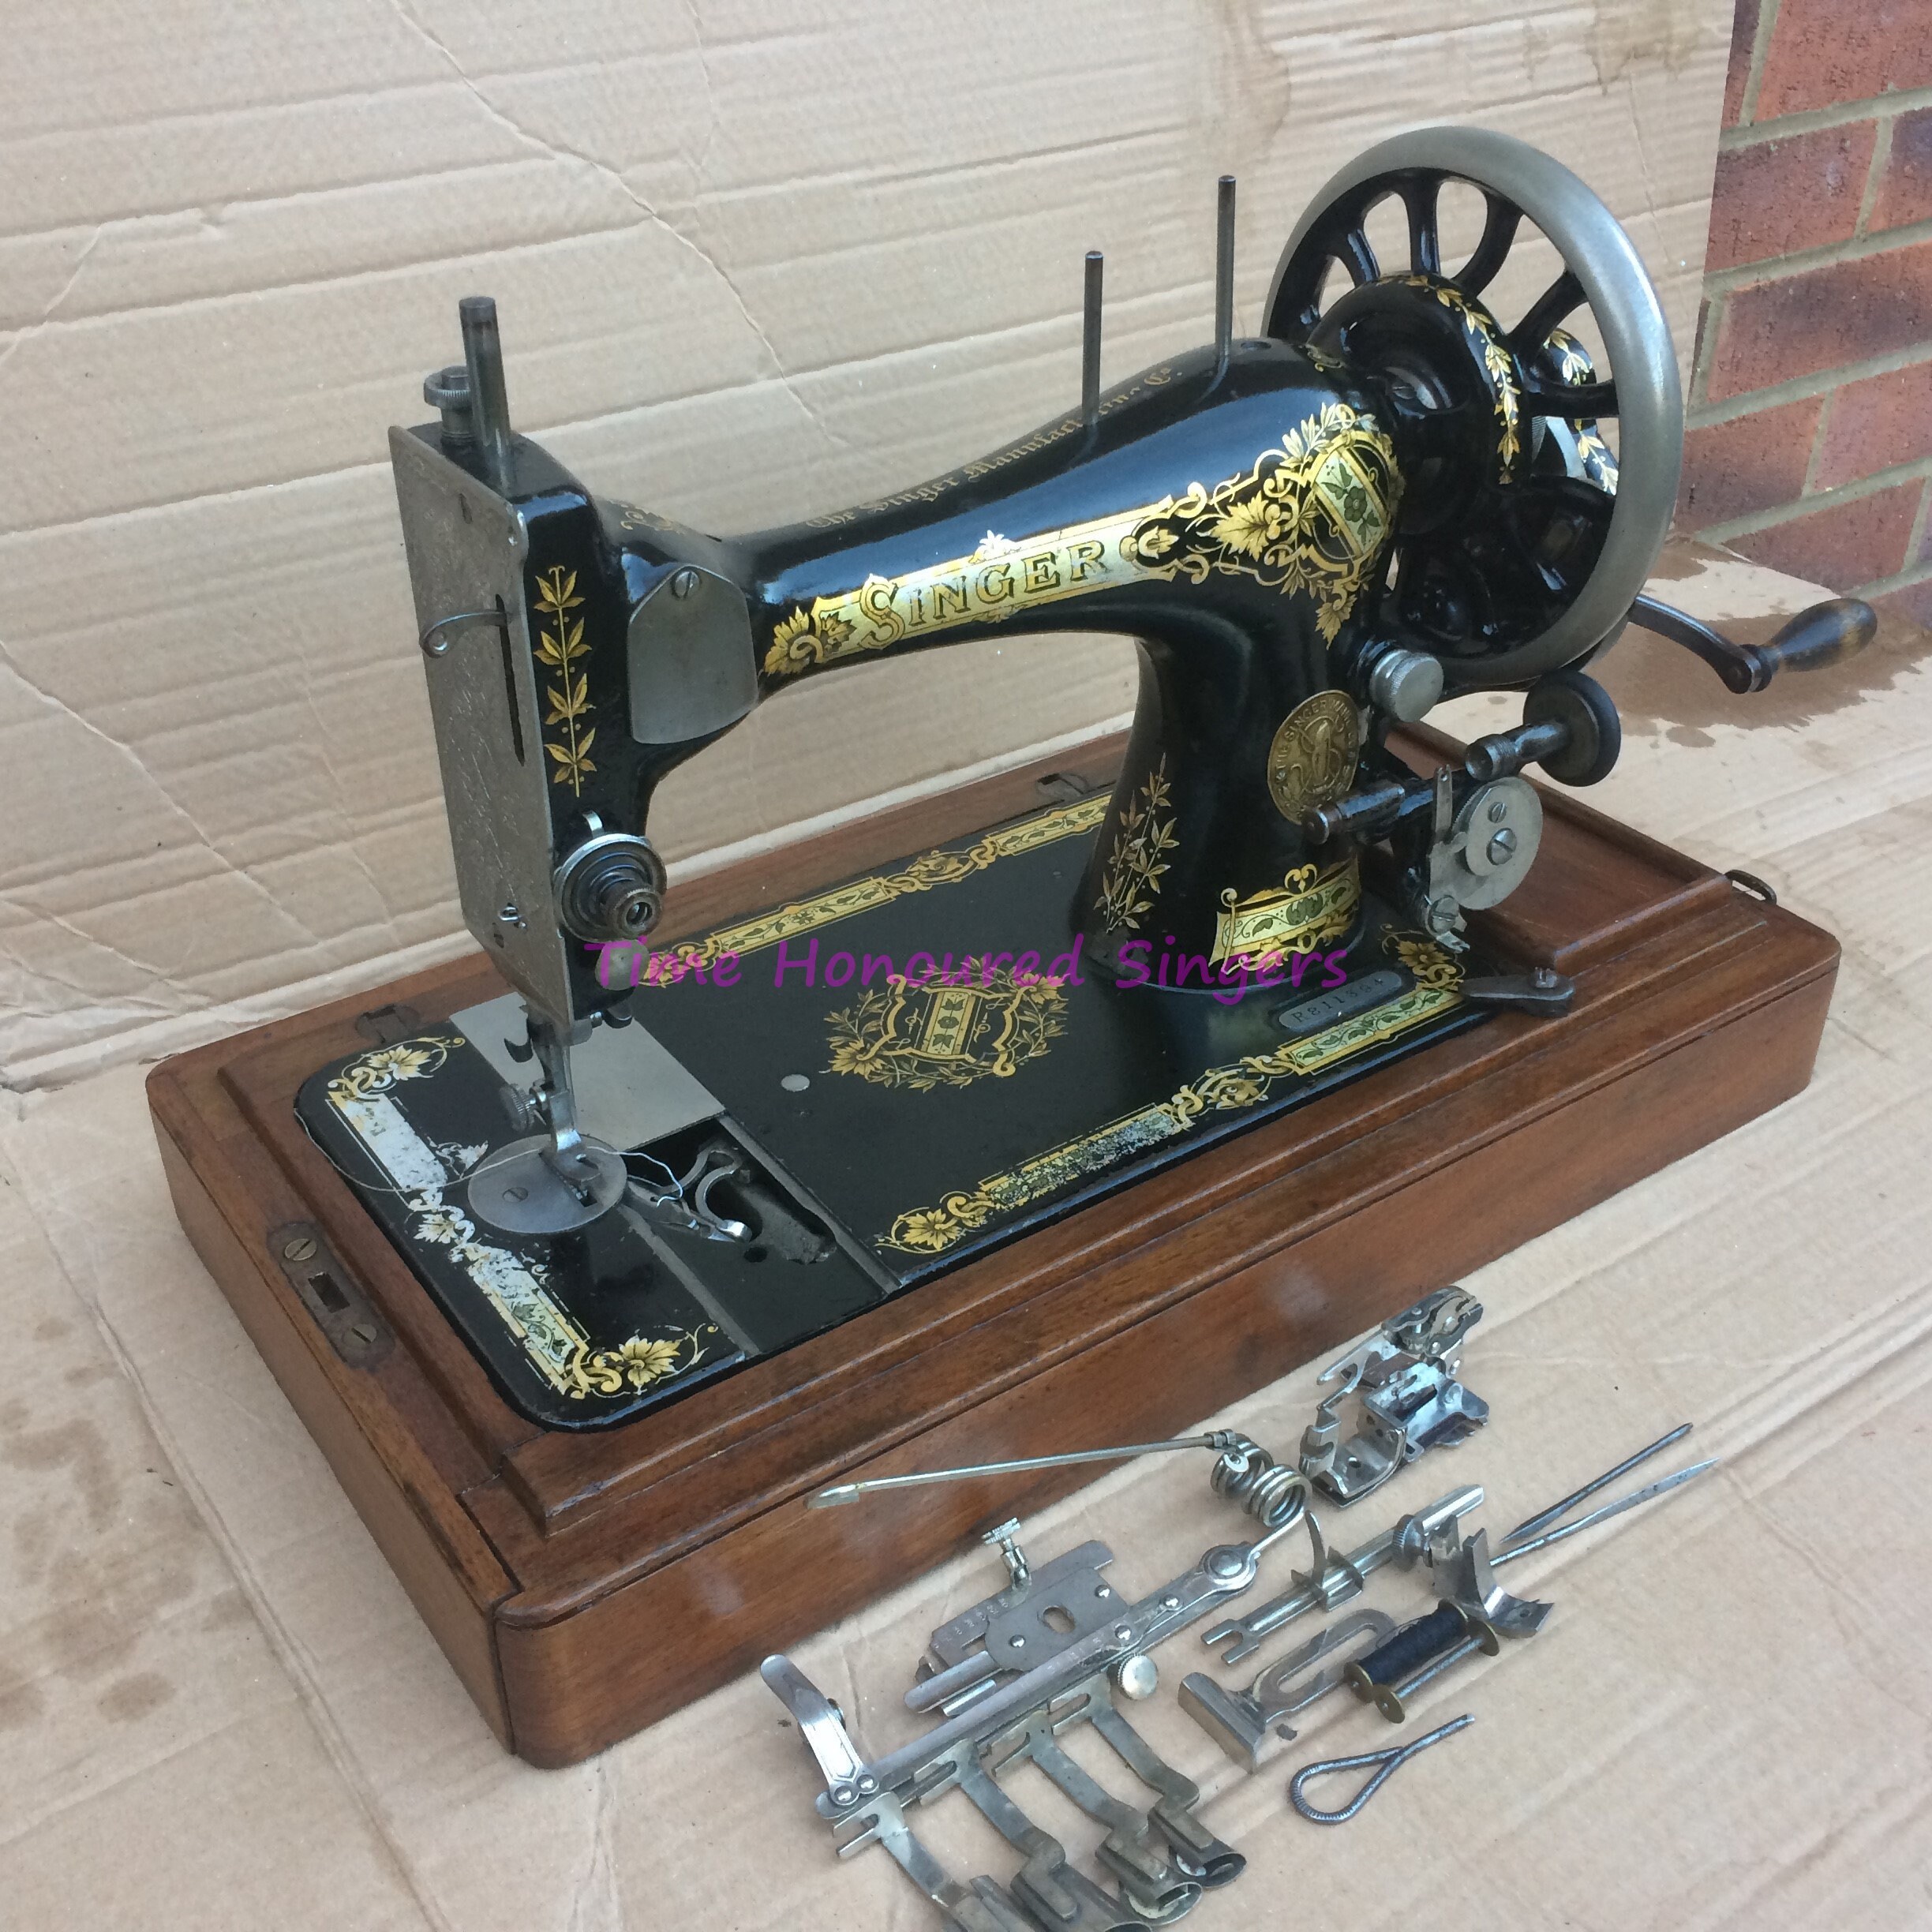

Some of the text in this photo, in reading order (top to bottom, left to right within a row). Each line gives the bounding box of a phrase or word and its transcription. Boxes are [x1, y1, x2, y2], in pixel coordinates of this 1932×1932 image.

[806, 511, 856, 528] The
[859, 477, 960, 514] Singer
[858, 540, 1107, 650] SINGER
[1284, 699, 1327, 742] SINGER
